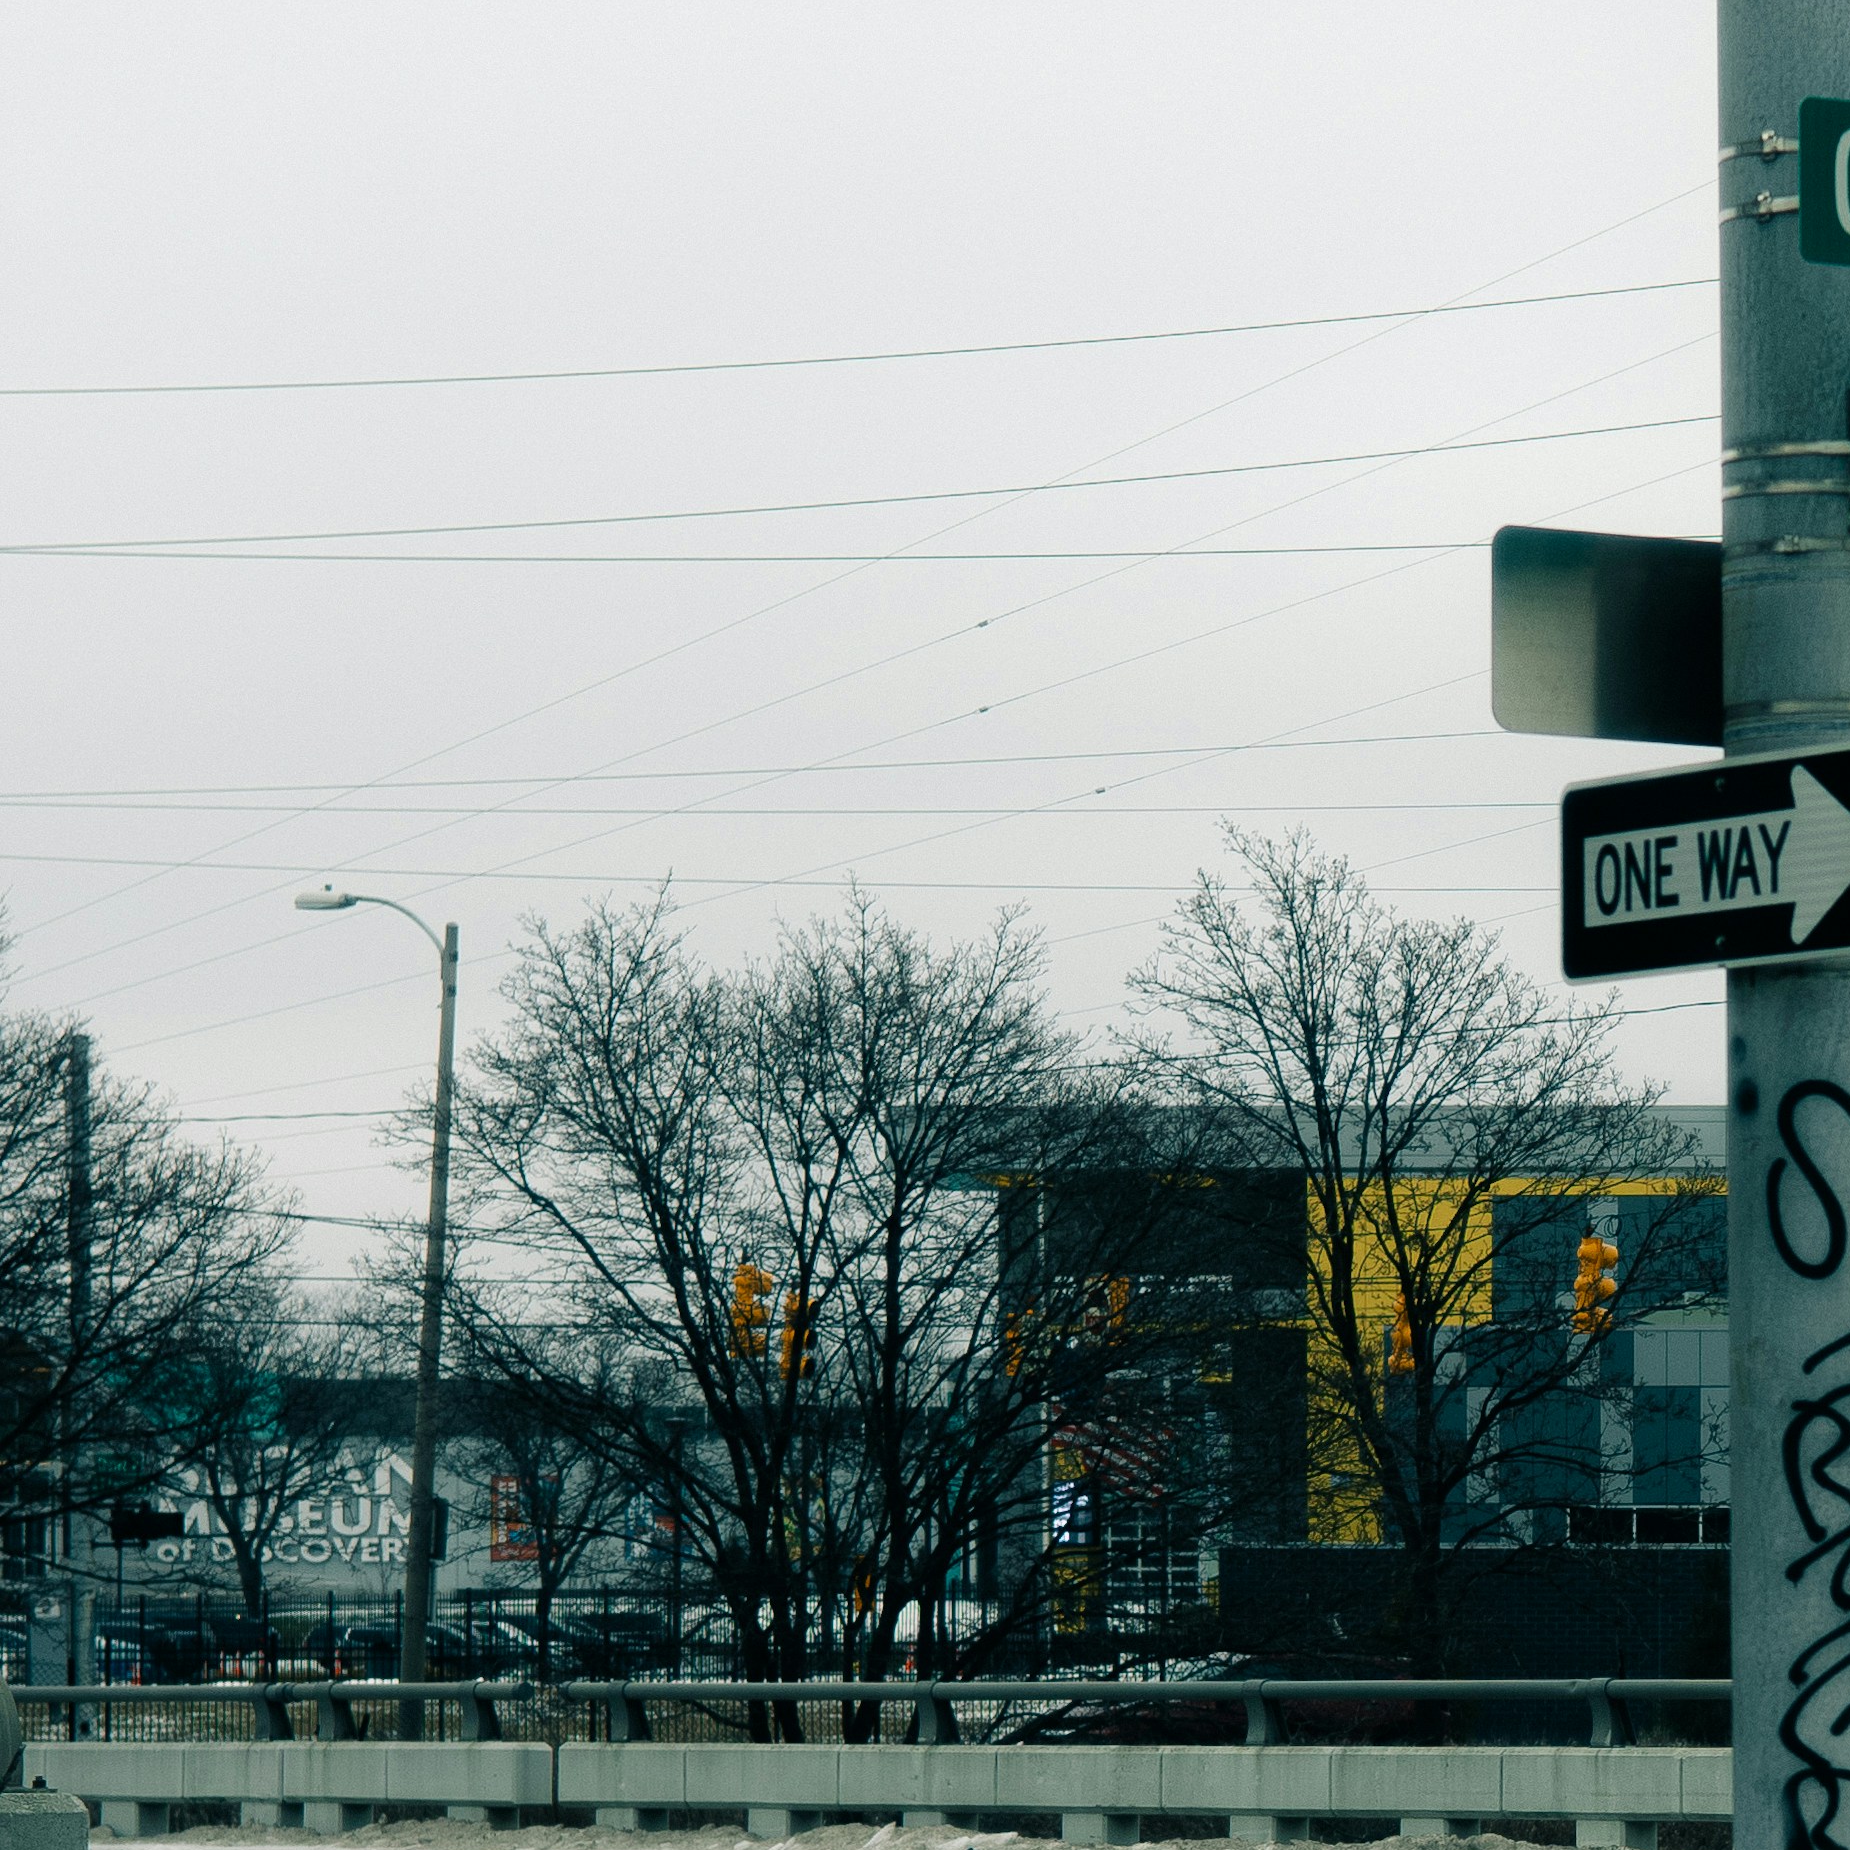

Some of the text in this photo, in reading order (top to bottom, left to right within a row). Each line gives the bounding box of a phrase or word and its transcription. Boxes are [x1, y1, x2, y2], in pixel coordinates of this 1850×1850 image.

[1595, 819, 1792, 916] ONE WAY
[157, 1536, 197, 1563] of
